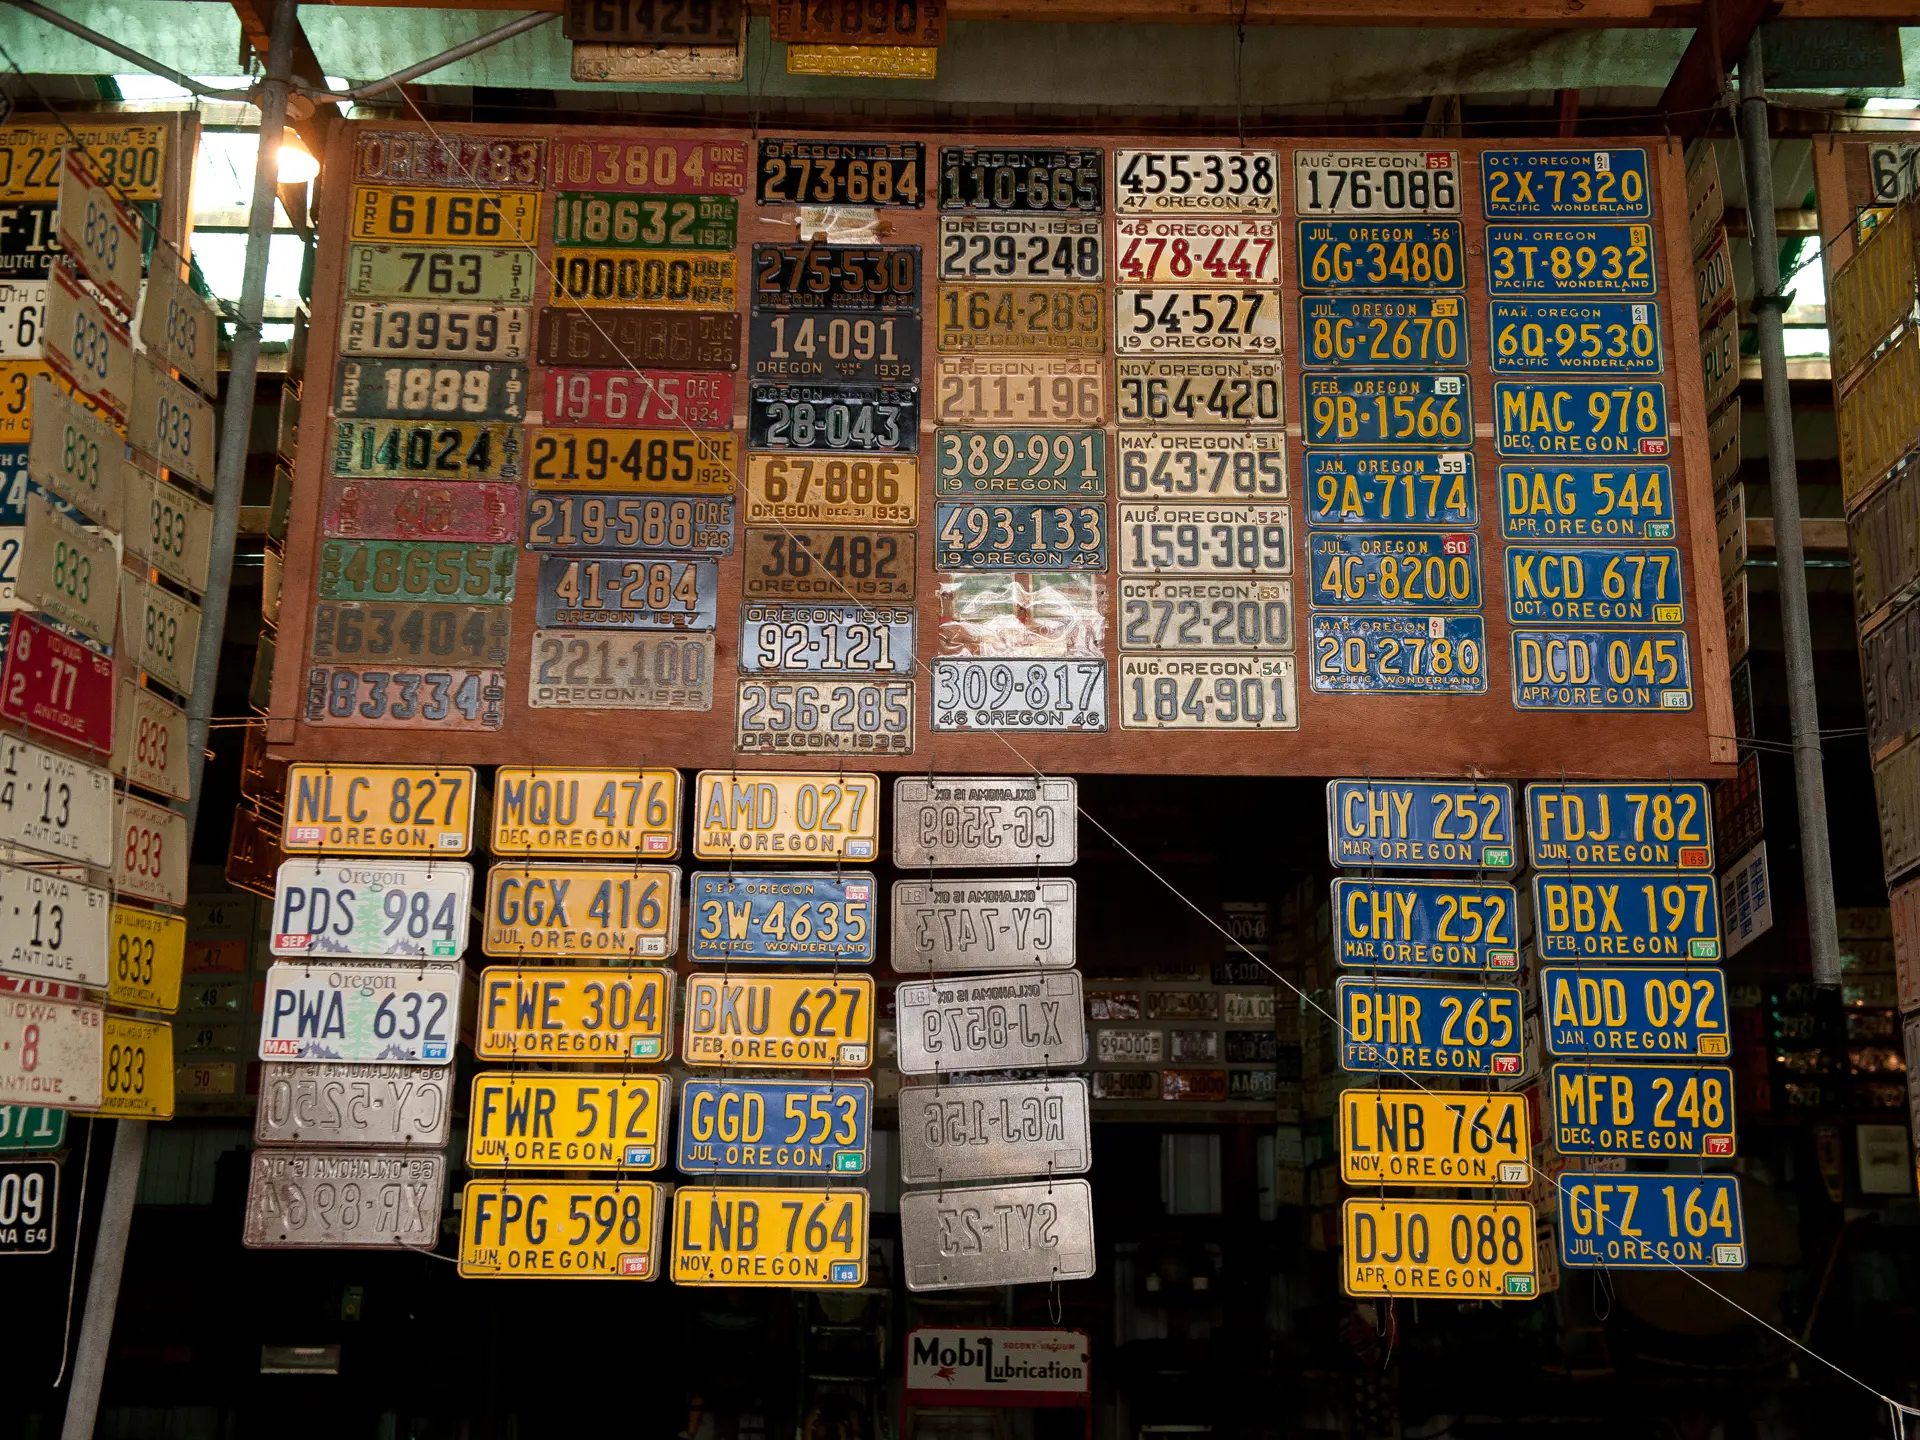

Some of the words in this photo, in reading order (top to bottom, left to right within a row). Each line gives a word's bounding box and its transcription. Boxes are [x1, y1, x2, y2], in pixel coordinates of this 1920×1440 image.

[554, 144, 705, 186] 103804
[710, 147, 744, 163] ORE
[709, 172, 743, 187] 1920
[389, 195, 501, 236] 6166
[556, 200, 696, 245] 118632
[399, 252, 482, 295] 763
[554, 257, 691, 300] 100000
[73, 312, 109, 378] 833
[371, 311, 498, 351] 13959
[385, 367, 490, 413] 1889
[1503, 390, 1574, 433] MAC
[1588, 391, 1658, 433] 978
[156, 397, 192, 456] 833
[360, 426, 491, 472] 14024
[1539, 436, 1629, 451] OREGON
[63, 425, 99, 489] 833
[1443, 461, 1463, 473] 59
[943, 478, 963, 490] 19
[974, 478, 1068, 491] OREGON
[1079, 479, 1099, 491] 41
[1507, 473, 1576, 516] DAG
[1593, 473, 1663, 516] 544
[343, 548, 494, 596] 48655
[1514, 555, 1585, 599] KCD
[1602, 556, 1670, 600] 677
[335, 609, 486, 656] 63404
[555, 610, 635, 624] OREGON
[653, 612, 700, 625] 1927
[1320, 675, 1372, 684] PACIFIC
[1384, 675, 1480, 685] WONDERLAND
[1520, 640, 1591, 684] DCD
[1609, 640, 1678, 684] 045
[329, 671, 481, 720] 83334
[1671, 697, 1685, 706] 68
[36, 754, 76, 779] IOWA
[297, 776, 370, 823] NLC
[390, 777, 462, 825] 827
[503, 780, 578, 825] MQU
[595, 782, 667, 826] 476
[705, 782, 777, 830] AMD
[797, 784, 867, 832] 027
[1344, 791, 1414, 839] CHY
[1432, 794, 1504, 841] 252
[1538, 794, 1611, 841] FDJ
[1625, 793, 1700, 842] 782
[24, 823, 78, 850] ANTIQUE
[125, 825, 163, 877] 833
[296, 829, 319, 839] FEB
[338, 868, 407, 892] Oregon
[498, 878, 571, 927] GGX
[589, 879, 661, 928] 416
[282, 887, 356, 936] PDS
[383, 889, 456, 940] 984
[1348, 891, 1418, 940] CHY
[1436, 895, 1509, 944] 252
[1546, 884, 1623, 933] BBX
[1642, 884, 1708, 933] 197
[118, 934, 154, 984] 833
[282, 935, 305, 947] SEP
[271, 989, 345, 1038] PWA
[373, 991, 448, 1040] 632
[487, 981, 566, 1030] FWE
[582, 982, 656, 1031] 304
[694, 985, 770, 1035] BKU
[790, 988, 861, 1037] 627
[1351, 993, 1422, 1045] BHR
[1440, 997, 1513, 1047] 265
[1554, 978, 1627, 1027] ADD
[1646, 978, 1719, 1029] 092
[107, 1044, 144, 1094] 833
[264, 1040, 299, 1054] MAR
[193, 1070, 211, 1088] 50
[1559, 1074, 1635, 1126] MFB
[1652, 1077, 1725, 1129] 248
[481, 1087, 556, 1138] FWR
[577, 1088, 650, 1139] 512
[691, 1091, 765, 1144] GGD
[785, 1094, 857, 1145] 553
[1350, 1101, 1424, 1153] LNB
[1445, 1104, 1518, 1155] 764
[1715, 1143, 1727, 1152] 72
[1509, 1171, 1521, 1181] 77
[474, 1194, 548, 1246] FPG
[569, 1194, 640, 1246] 598
[683, 1200, 759, 1252] LNB
[782, 1202, 853, 1253] 764
[1570, 1184, 1643, 1237] GFZ
[1662, 1185, 1733, 1238] 164
[1355, 1212, 1430, 1265] DJQ
[1451, 1214, 1523, 1265] 088
[1514, 1283, 1528, 1293] 78
